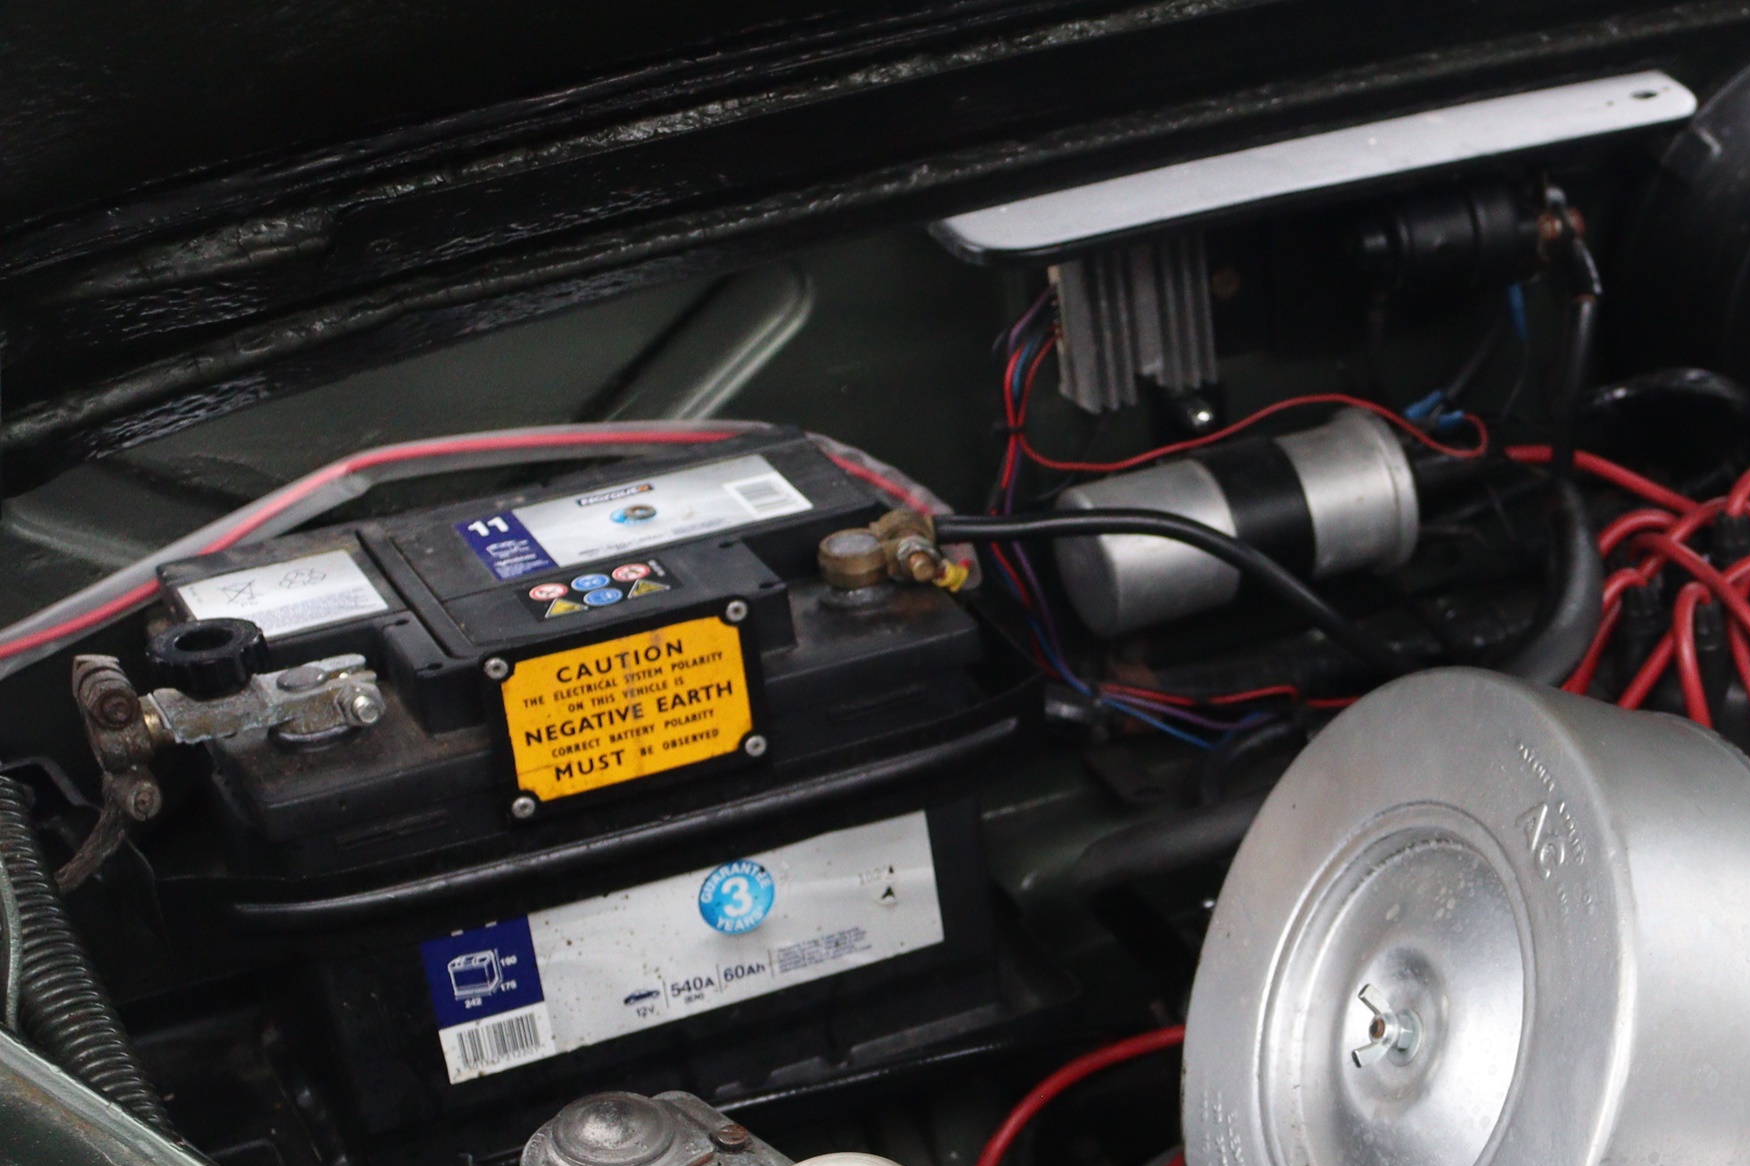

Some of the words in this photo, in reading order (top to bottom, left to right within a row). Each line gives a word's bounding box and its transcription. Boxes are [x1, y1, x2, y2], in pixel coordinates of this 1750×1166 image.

[468, 516, 509, 536] 11
[523, 695, 544, 709] THE
[554, 678, 617, 701] ELECTRICAL
[624, 667, 663, 684] SYSTEM
[671, 651, 723, 672] POLARITY
[556, 639, 683, 683] CAUTION
[525, 704, 644, 747] NEGATIVE
[657, 680, 733, 713] EARTH
[568, 701, 584, 713] ON
[591, 693, 615, 707] THIS
[623, 681, 667, 700] VEHICLE
[674, 676, 684, 687] IS
[552, 738, 601, 758] CORRECT
[609, 724, 655, 744] BATTERY
[664, 709, 715, 730] POLARITY
[555, 750, 625, 781] MUST
[640, 745, 653, 757] BE
[663, 728, 719, 750] OBSERVED
[1516, 802, 1566, 880] AC
[701, 862, 772, 904] GUARANTEE
[722, 876, 753, 917] 3
[716, 905, 764, 931] YEARS
[671, 977, 715, 997] 540A
[723, 963, 765, 982] 60Ah
[464, 997, 482, 1009] 242
